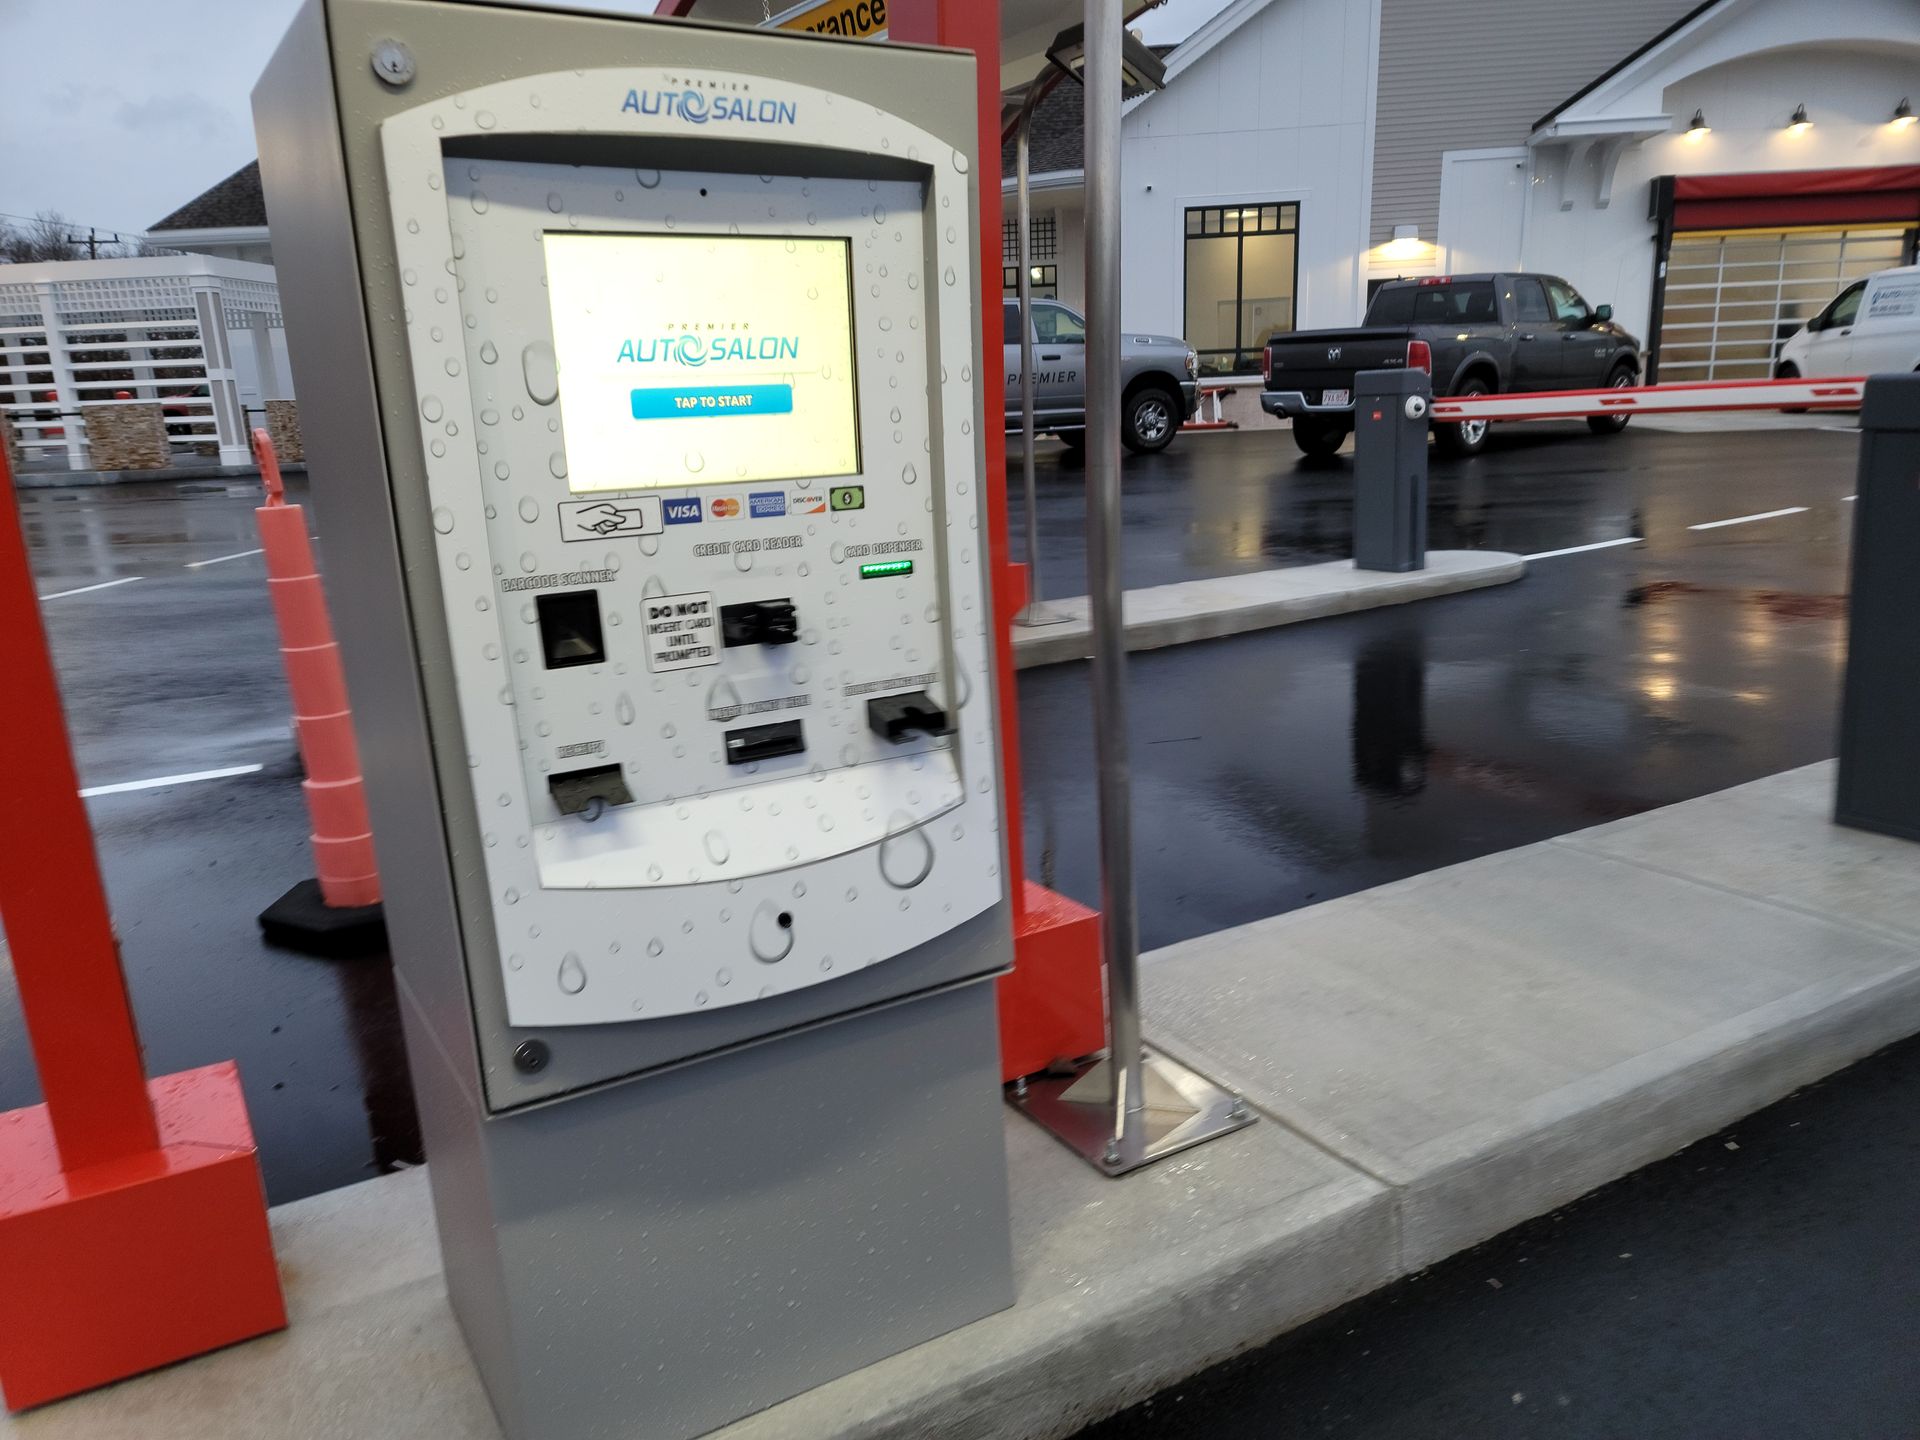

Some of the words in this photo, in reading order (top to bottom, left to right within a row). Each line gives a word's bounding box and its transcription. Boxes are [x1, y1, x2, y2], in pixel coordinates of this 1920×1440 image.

[670, 77, 750, 91] PREMIER
[667, 322, 751, 331] PREMIER
[674, 396, 698, 409] TAP
[699, 396, 716, 408] TO
[717, 394, 753, 407] START
[792, 496, 823, 504] DISCOVER
[667, 505, 699, 519] VISA
[693, 541, 731, 557] CREDIT
[732, 538, 761, 553] CARD
[762, 535, 803, 551] READER
[844, 544, 871, 558] CARD
[871, 538, 923, 555] DISPENSER
[501, 573, 558, 592] BARCODE
[558, 569, 615, 586] SCANNER
[648, 605, 673, 619] DO
[675, 600, 708, 616] NOT
[646, 620, 682, 635] INSERT
[685, 617, 713, 630] CARD
[666, 633, 701, 647] UNTIL
